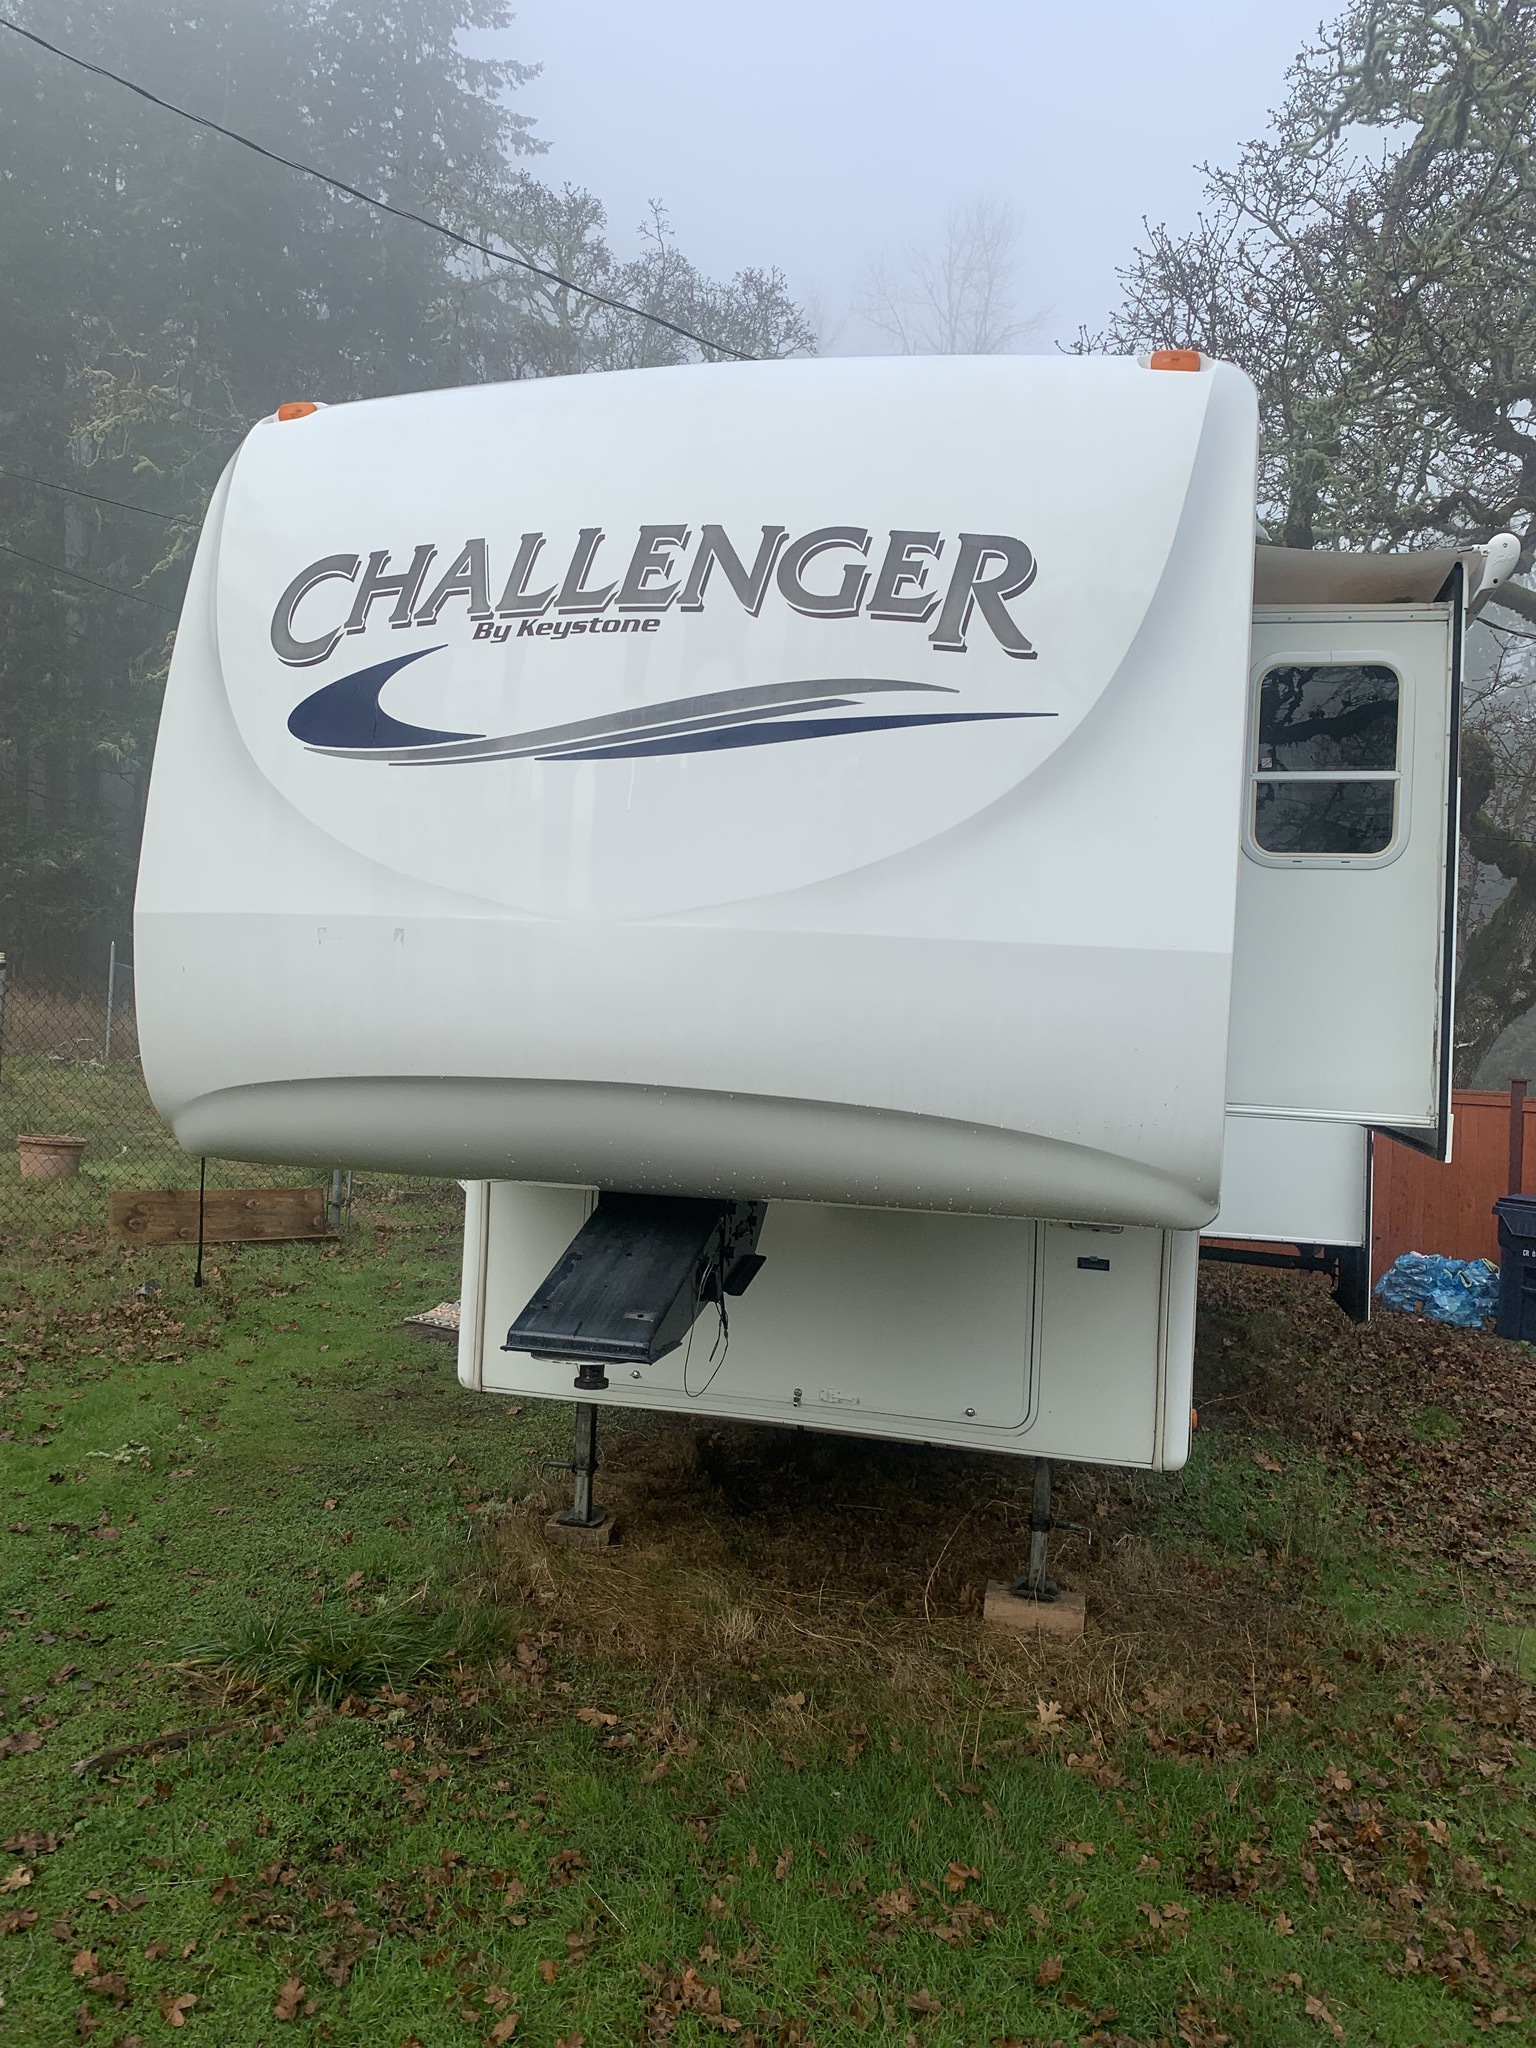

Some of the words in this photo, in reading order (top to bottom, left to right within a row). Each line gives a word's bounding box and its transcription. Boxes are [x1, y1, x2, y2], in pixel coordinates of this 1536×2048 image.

[270, 523, 1038, 668] CHALLENGER
[472, 621, 512, 644] By
[516, 618, 661, 640] Keystone
